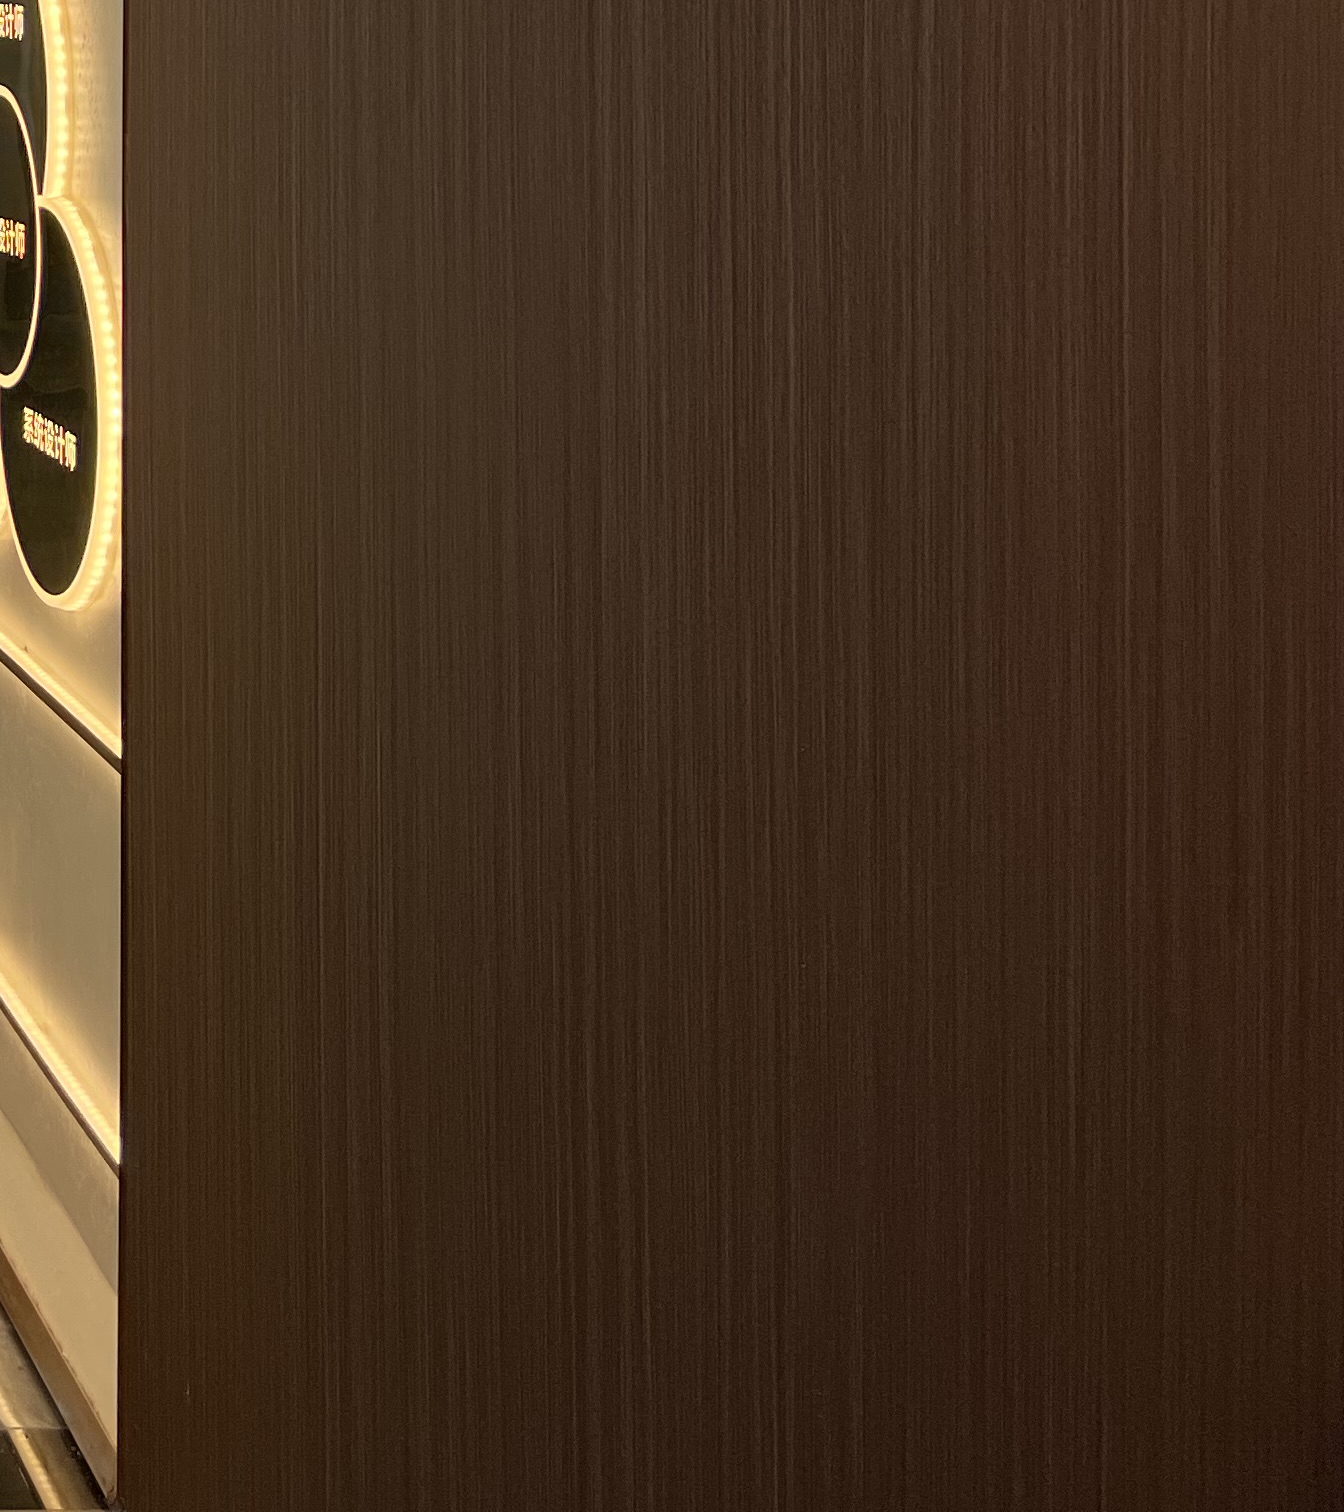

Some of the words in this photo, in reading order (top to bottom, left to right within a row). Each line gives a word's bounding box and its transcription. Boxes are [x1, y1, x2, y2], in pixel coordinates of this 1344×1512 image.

[23, 407, 77, 474] 系统设计师
